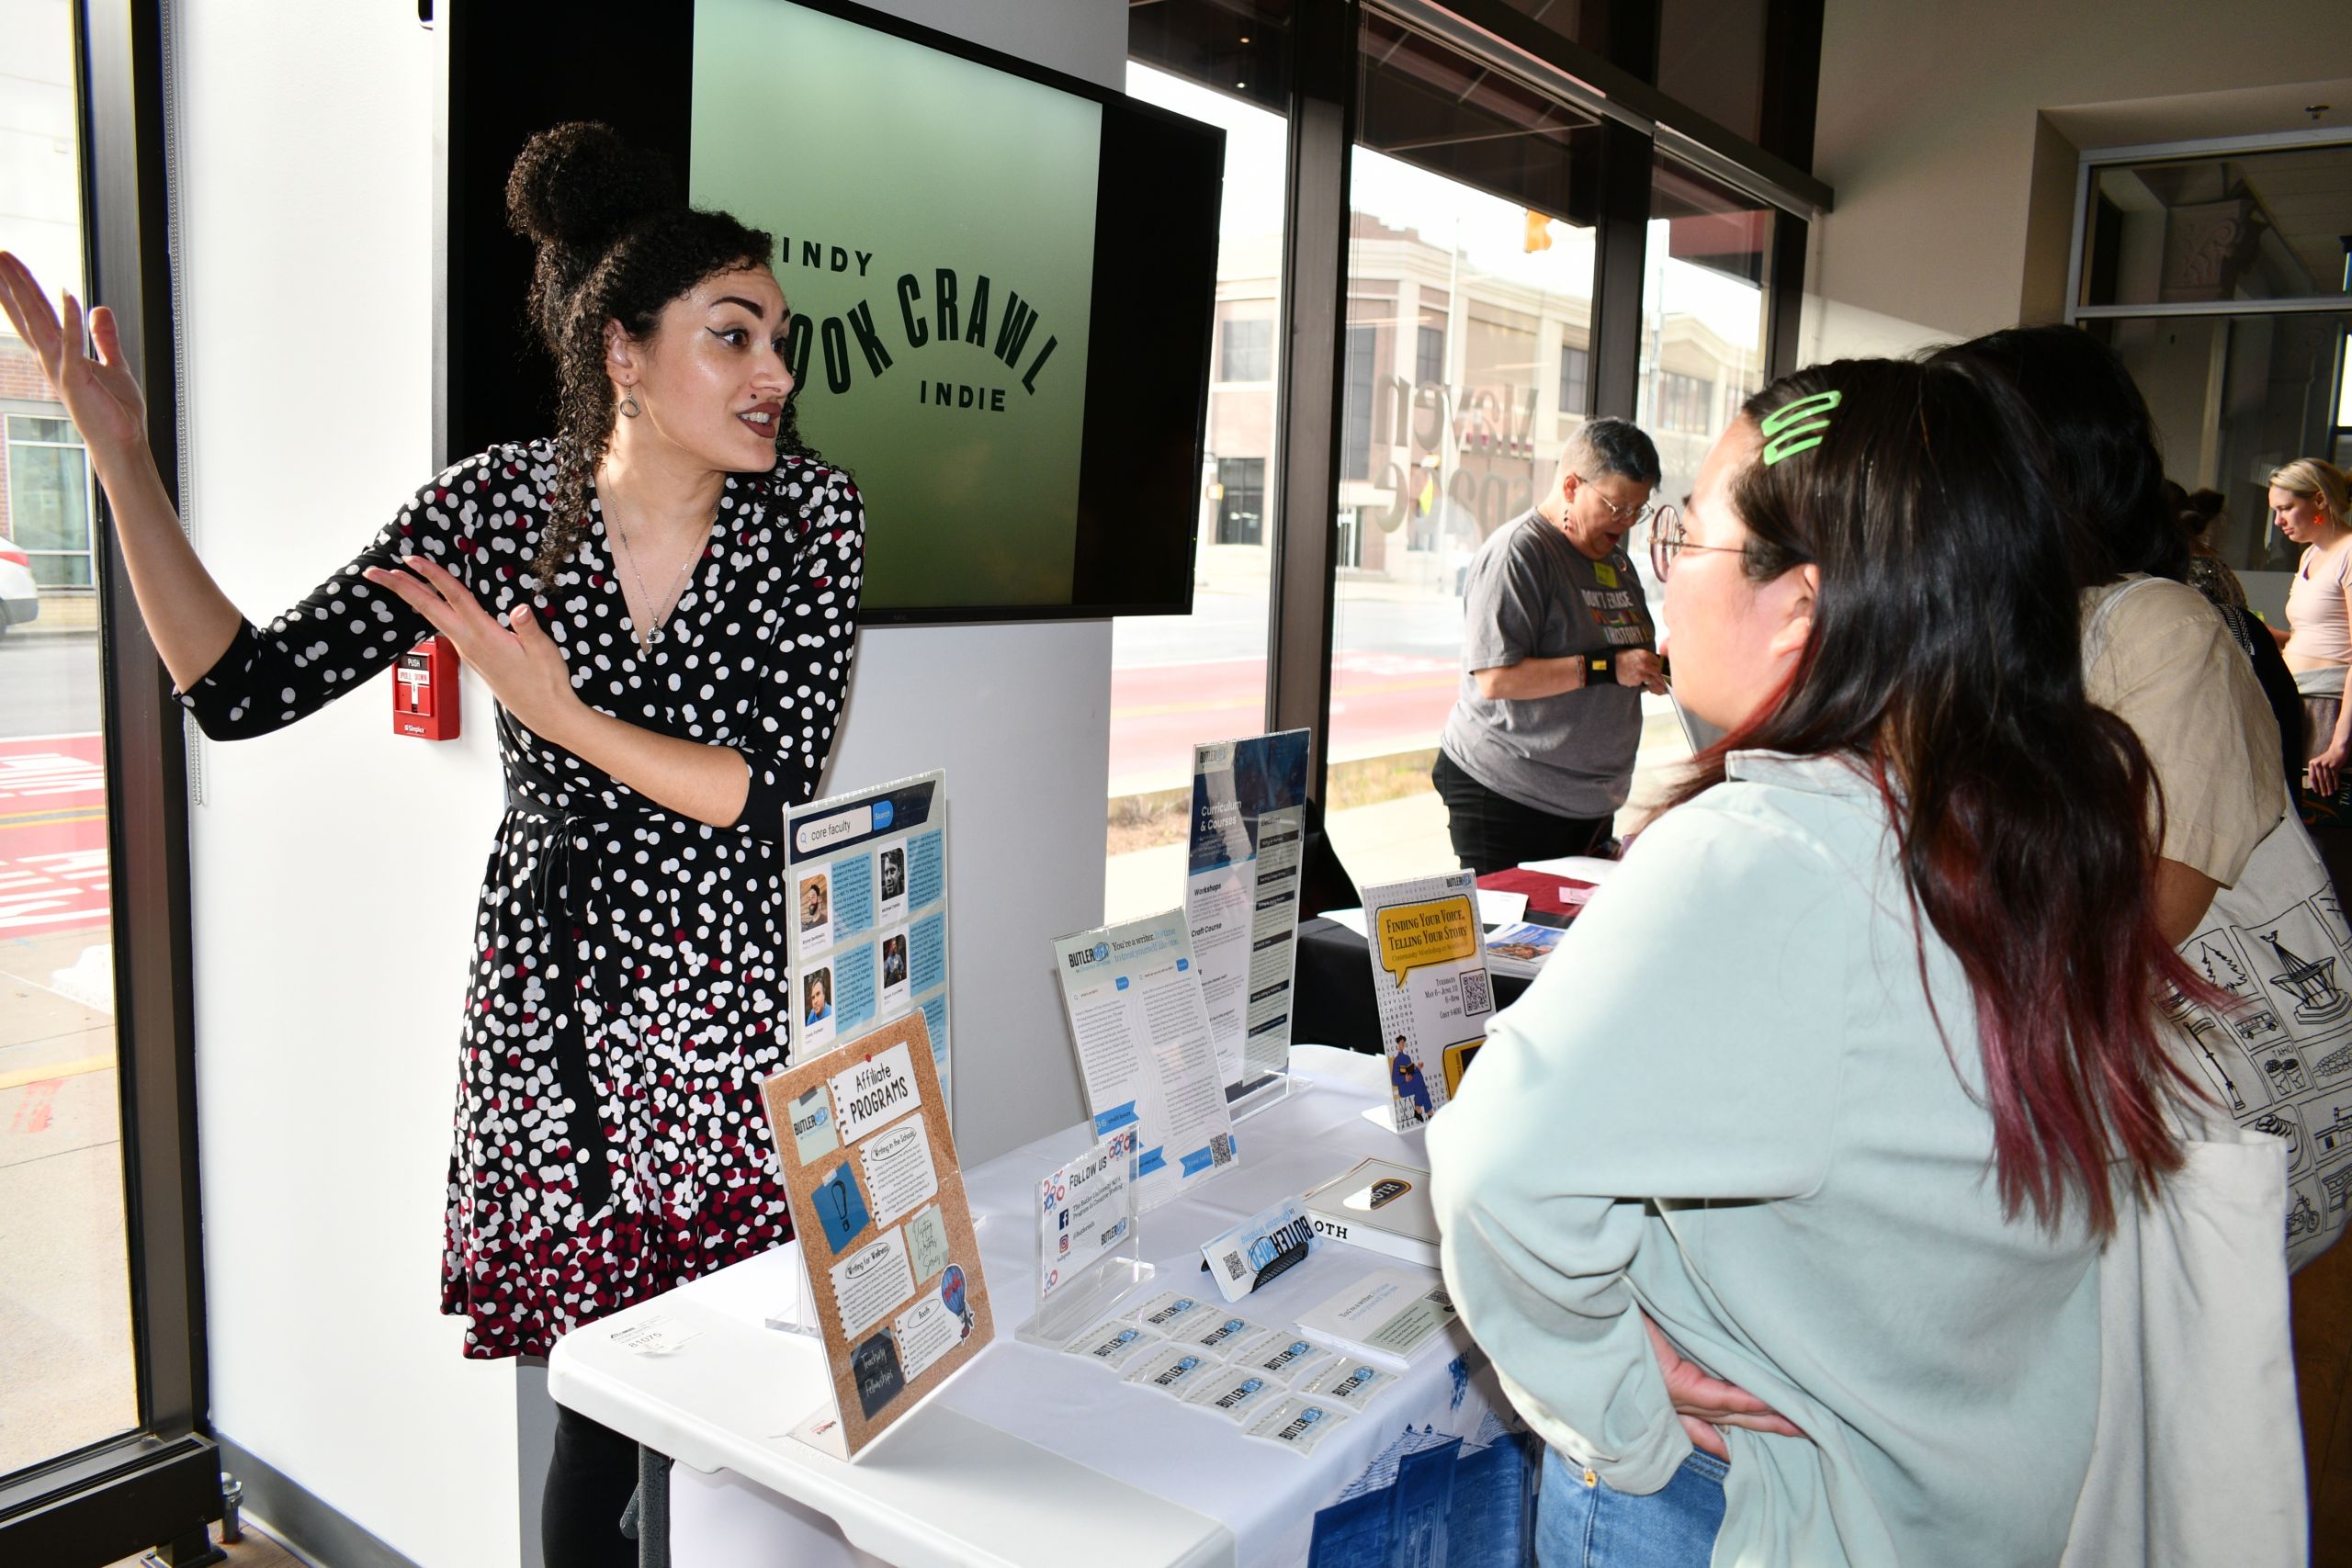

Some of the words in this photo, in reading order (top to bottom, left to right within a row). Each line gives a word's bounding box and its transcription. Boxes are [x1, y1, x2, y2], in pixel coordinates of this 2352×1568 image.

[782, 236, 873, 276] INDY
[786, 299, 894, 395] OOK
[897, 267, 1058, 396] CRAWL
[920, 379, 1006, 412] INDIE
[407, 658, 421, 668] PUSH
[1201, 800, 1242, 817] Curriculum
[810, 825, 828, 841] core
[828, 818, 851, 836] faculty
[1207, 816, 1237, 830] Courses
[1193, 883, 1222, 897] Workshops
[1191, 925, 1204, 937] Craft
[1204, 922, 1222, 934] Course
[1386, 917, 1419, 934] FINDING
[1419, 912, 1441, 928] YOUR
[1112, 939, 1131, 952] You're
[1388, 932, 1422, 951] TELLING
[1424, 928, 1444, 944] YOUR
[1445, 925, 1467, 941] STORY
[2271, 1044, 2294, 1059] TAHO
[855, 1064, 892, 1092] Affiliate
[850, 1076, 908, 1123] PROGRAMS
[874, 1141, 890, 1158] Writing
[1069, 1164, 1096, 1190] FOLLOW
[1098, 1156, 1107, 1171] US
[1315, 1220, 1348, 1239] OTH
[847, 1259, 865, 1278] Writing
[863, 1253, 871, 1267] for
[870, 1243, 889, 1262] Wellness
[860, 1347, 887, 1372] Teaching
[864, 1370, 893, 1397] Fellowships
